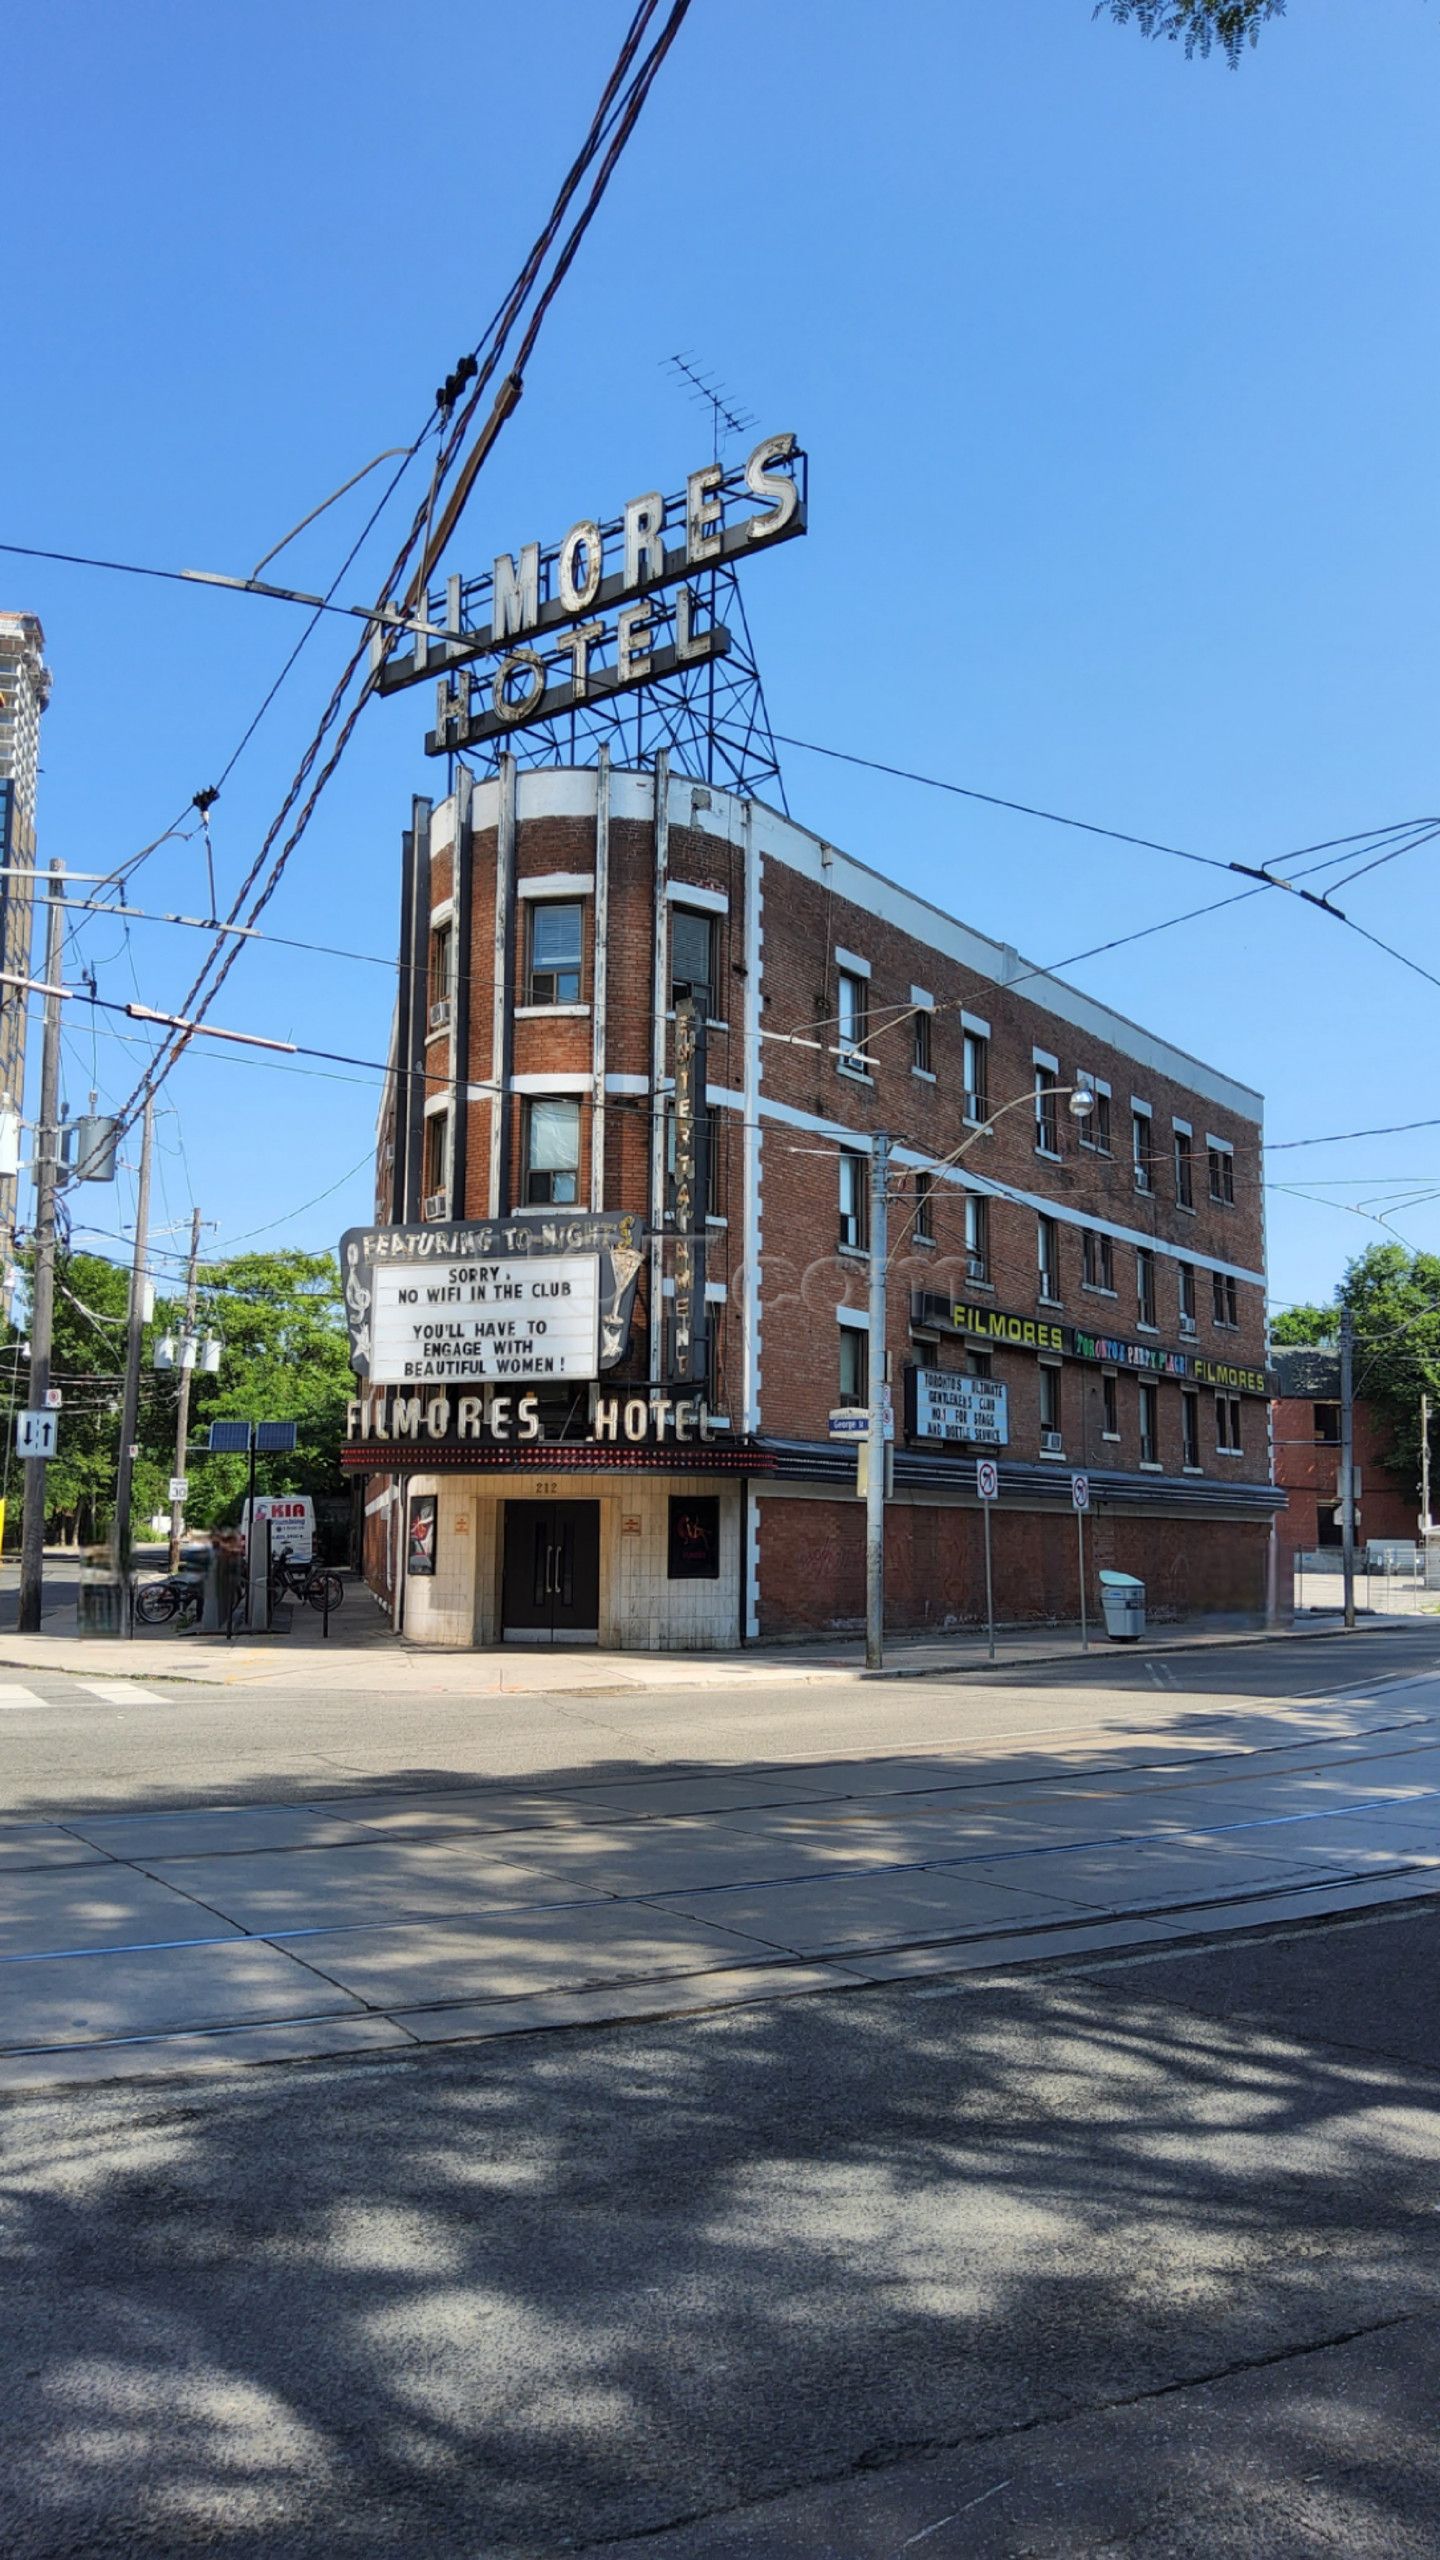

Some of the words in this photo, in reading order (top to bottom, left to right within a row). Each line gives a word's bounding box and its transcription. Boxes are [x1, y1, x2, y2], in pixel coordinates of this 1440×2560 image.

[435, 588, 712, 748] HOTEL
[363, 1226, 494, 1258] FEATURING
[398, 1288, 419, 1304] NO
[427, 1286, 462, 1302] WIFI
[470, 1285, 487, 1301] IN
[494, 1284, 523, 1300] THE
[531, 1281, 572, 1298] CLUB
[413, 1323, 465, 1339] YOU'LL
[474, 1321, 517, 1337] HAVE
[527, 1319, 548, 1336] TO
[953, 1304, 1064, 1350] FILMORES
[423, 1341, 482, 1358] ENGAGE
[493, 1339, 534, 1355] WITH
[404, 1360, 487, 1377] BEAUTIFUL
[1194, 1360, 1266, 1392] FILMORES
[979, 1397, 995, 1411] CLUB
[346, 1396, 540, 1441] FILMORES
[596, 1398, 716, 1442] HOTEL
[833, 1419, 857, 1431] George
[955, 1409, 967, 1423] FOR
[928, 1422, 942, 1435] AND
[975, 1428, 1000, 1442] SERVICE
[535, 1482, 558, 1494] 212
[271, 1503, 305, 1518] KIA
